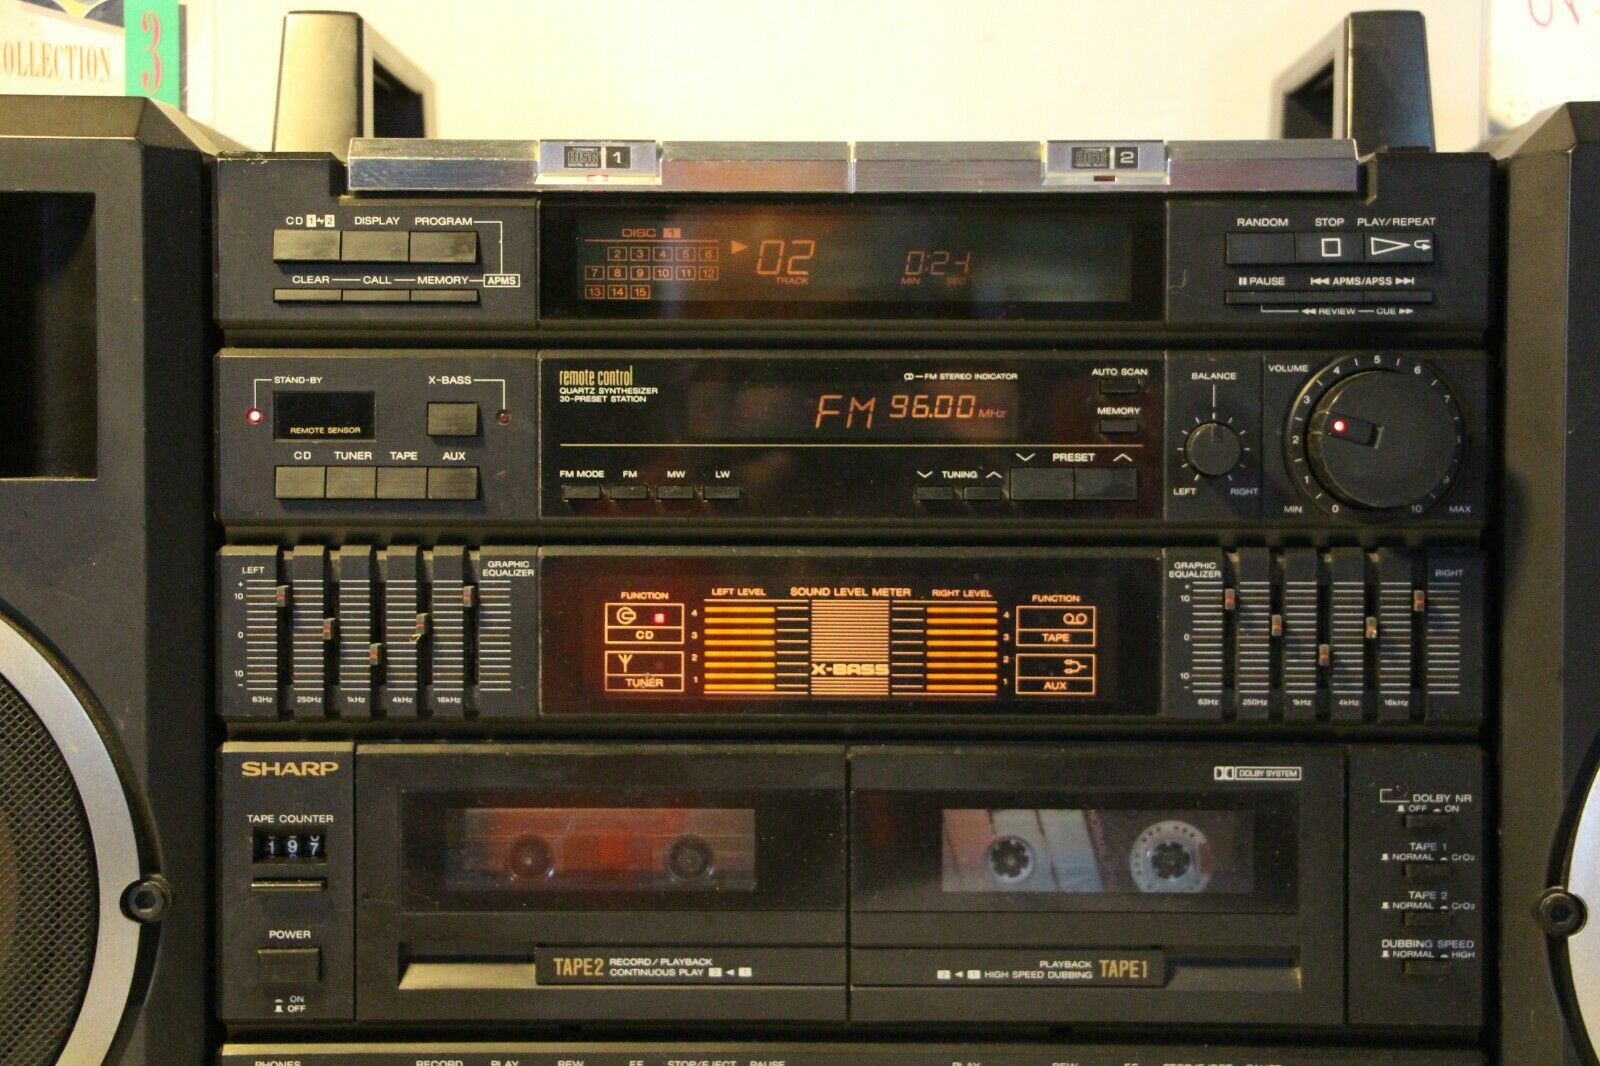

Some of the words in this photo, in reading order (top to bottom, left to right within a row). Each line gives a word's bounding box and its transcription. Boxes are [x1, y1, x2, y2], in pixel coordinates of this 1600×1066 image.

[141, 9, 163, 93] 3
[613, 152, 621, 163] 1
[1120, 151, 1134, 163] 2
[286, 216, 303, 225] CD
[354, 216, 400, 225] DISPLAY
[415, 217, 473, 226] PROGRAM
[1237, 218, 1288, 226] RANDOM
[1315, 218, 1344, 226] STOP
[1357, 217, 1436, 226] PLAY/REPEAT
[622, 228, 657, 237] DISC
[614, 250, 621, 259] 2
[636, 250, 644, 259] 3
[659, 250, 666, 259] 4
[705, 250, 712, 259] 6
[756, 240, 816, 275] 02
[591, 269, 598, 278] 7
[614, 269, 621, 278] 8
[636, 269, 644, 278] 9
[656, 269, 669, 278] 10
[682, 269, 691, 278] 11
[703, 269, 714, 278] 12
[292, 275, 329, 284] CLEAR
[363, 275, 392, 284] CALL
[417, 276, 469, 284] MEMORY
[488, 276, 516, 285] APMS
[777, 276, 808, 284] TRACK
[1250, 277, 1285, 285] PAUSE
[1332, 277, 1392, 286] APMS/APSS
[589, 288, 600, 297] 13
[612, 288, 623, 297] 14
[635, 288, 646, 297] 15
[1318, 307, 1355, 315] REVIEW
[1376, 307, 1395, 315] CUE
[1092, 368, 1118, 376] AUTO
[1121, 368, 1148, 376] SCAN
[1268, 364, 1308, 373] VOLUME
[559, 369, 595, 386] remote
[597, 365, 633, 386] control
[1191, 372, 1236, 380] BALANCE
[1303, 395, 1310, 404] 3
[1333, 366, 1340, 375] 4
[1373, 355, 1381, 364] 5
[1414, 366, 1421, 375] 6
[274, 376, 322, 384] STAND-BY
[428, 376, 472, 385] X-BASS
[559, 387, 595, 395] QUARTZ
[598, 387, 658, 395] SYNTHESIZER
[815, 395, 876, 429] FM
[889, 395, 977, 418] 96.00
[1097, 407, 1140, 415] MEMORY
[1292, 436, 1299, 444] 2
[294, 451, 311, 460] CD
[334, 451, 372, 460] TUNER
[390, 451, 417, 460] TAPE
[443, 451, 466, 461] AUX
[1052, 453, 1095, 462] PRESET
[559, 470, 574, 478] FM
[577, 470, 604, 478] MODE
[623, 470, 637, 478] FM
[667, 470, 686, 478] MW
[715, 470, 730, 478] LW
[941, 471, 978, 479] TUNING
[1173, 487, 1196, 495] LEFT
[1230, 487, 1258, 495] RIGHT
[1284, 505, 1302, 513] MIN
[1332, 505, 1339, 513] 0
[1449, 505, 1471, 513] MAX
[242, 566, 264, 574] LEFT
[483, 569, 534, 577] EQUALIZER
[1169, 570, 1221, 578] EQUALIZER
[1435, 569, 1463, 577] RIGHT
[621, 592, 669, 600] FUNCTION
[712, 588, 735, 596] LEFT
[737, 588, 766, 596] LEVEL
[790, 587, 830, 596] SOUND
[834, 588, 867, 596] LEVEL
[872, 588, 912, 597] METER
[932, 589, 960, 597] RIGHT
[963, 589, 992, 597] LEVEL
[1032, 594, 1080, 602] FUNCTION
[636, 631, 654, 639] CD
[1042, 634, 1069, 642] TAPE
[811, 664, 889, 676] X-BASS
[625, 679, 664, 687] TUNER
[1044, 681, 1066, 690] AUX
[241, 761, 339, 776] SHARP
[1413, 794, 1450, 802] DOLBY
[1455, 794, 1472, 802] NR
[247, 814, 274, 823] TAPE
[279, 814, 333, 823] COUNTER
[1409, 842, 1437, 850] TAPE
[1408, 891, 1436, 899] TAPE
[1441, 891, 1447, 899] 2
[269, 930, 311, 939] POWER
[1382, 940, 1433, 948] DUBBING
[1437, 940, 1474, 948] SPEED
[610, 968, 675, 977] CONTINUOUS
[679, 968, 703, 977] PLAY
[984, 971, 1009, 979] HIGH
[1012, 971, 1045, 979] SPEED
[1048, 971, 1093, 979] DUBBING
[290, 995, 304, 1003] ON
[288, 1005, 306, 1013] OFF
